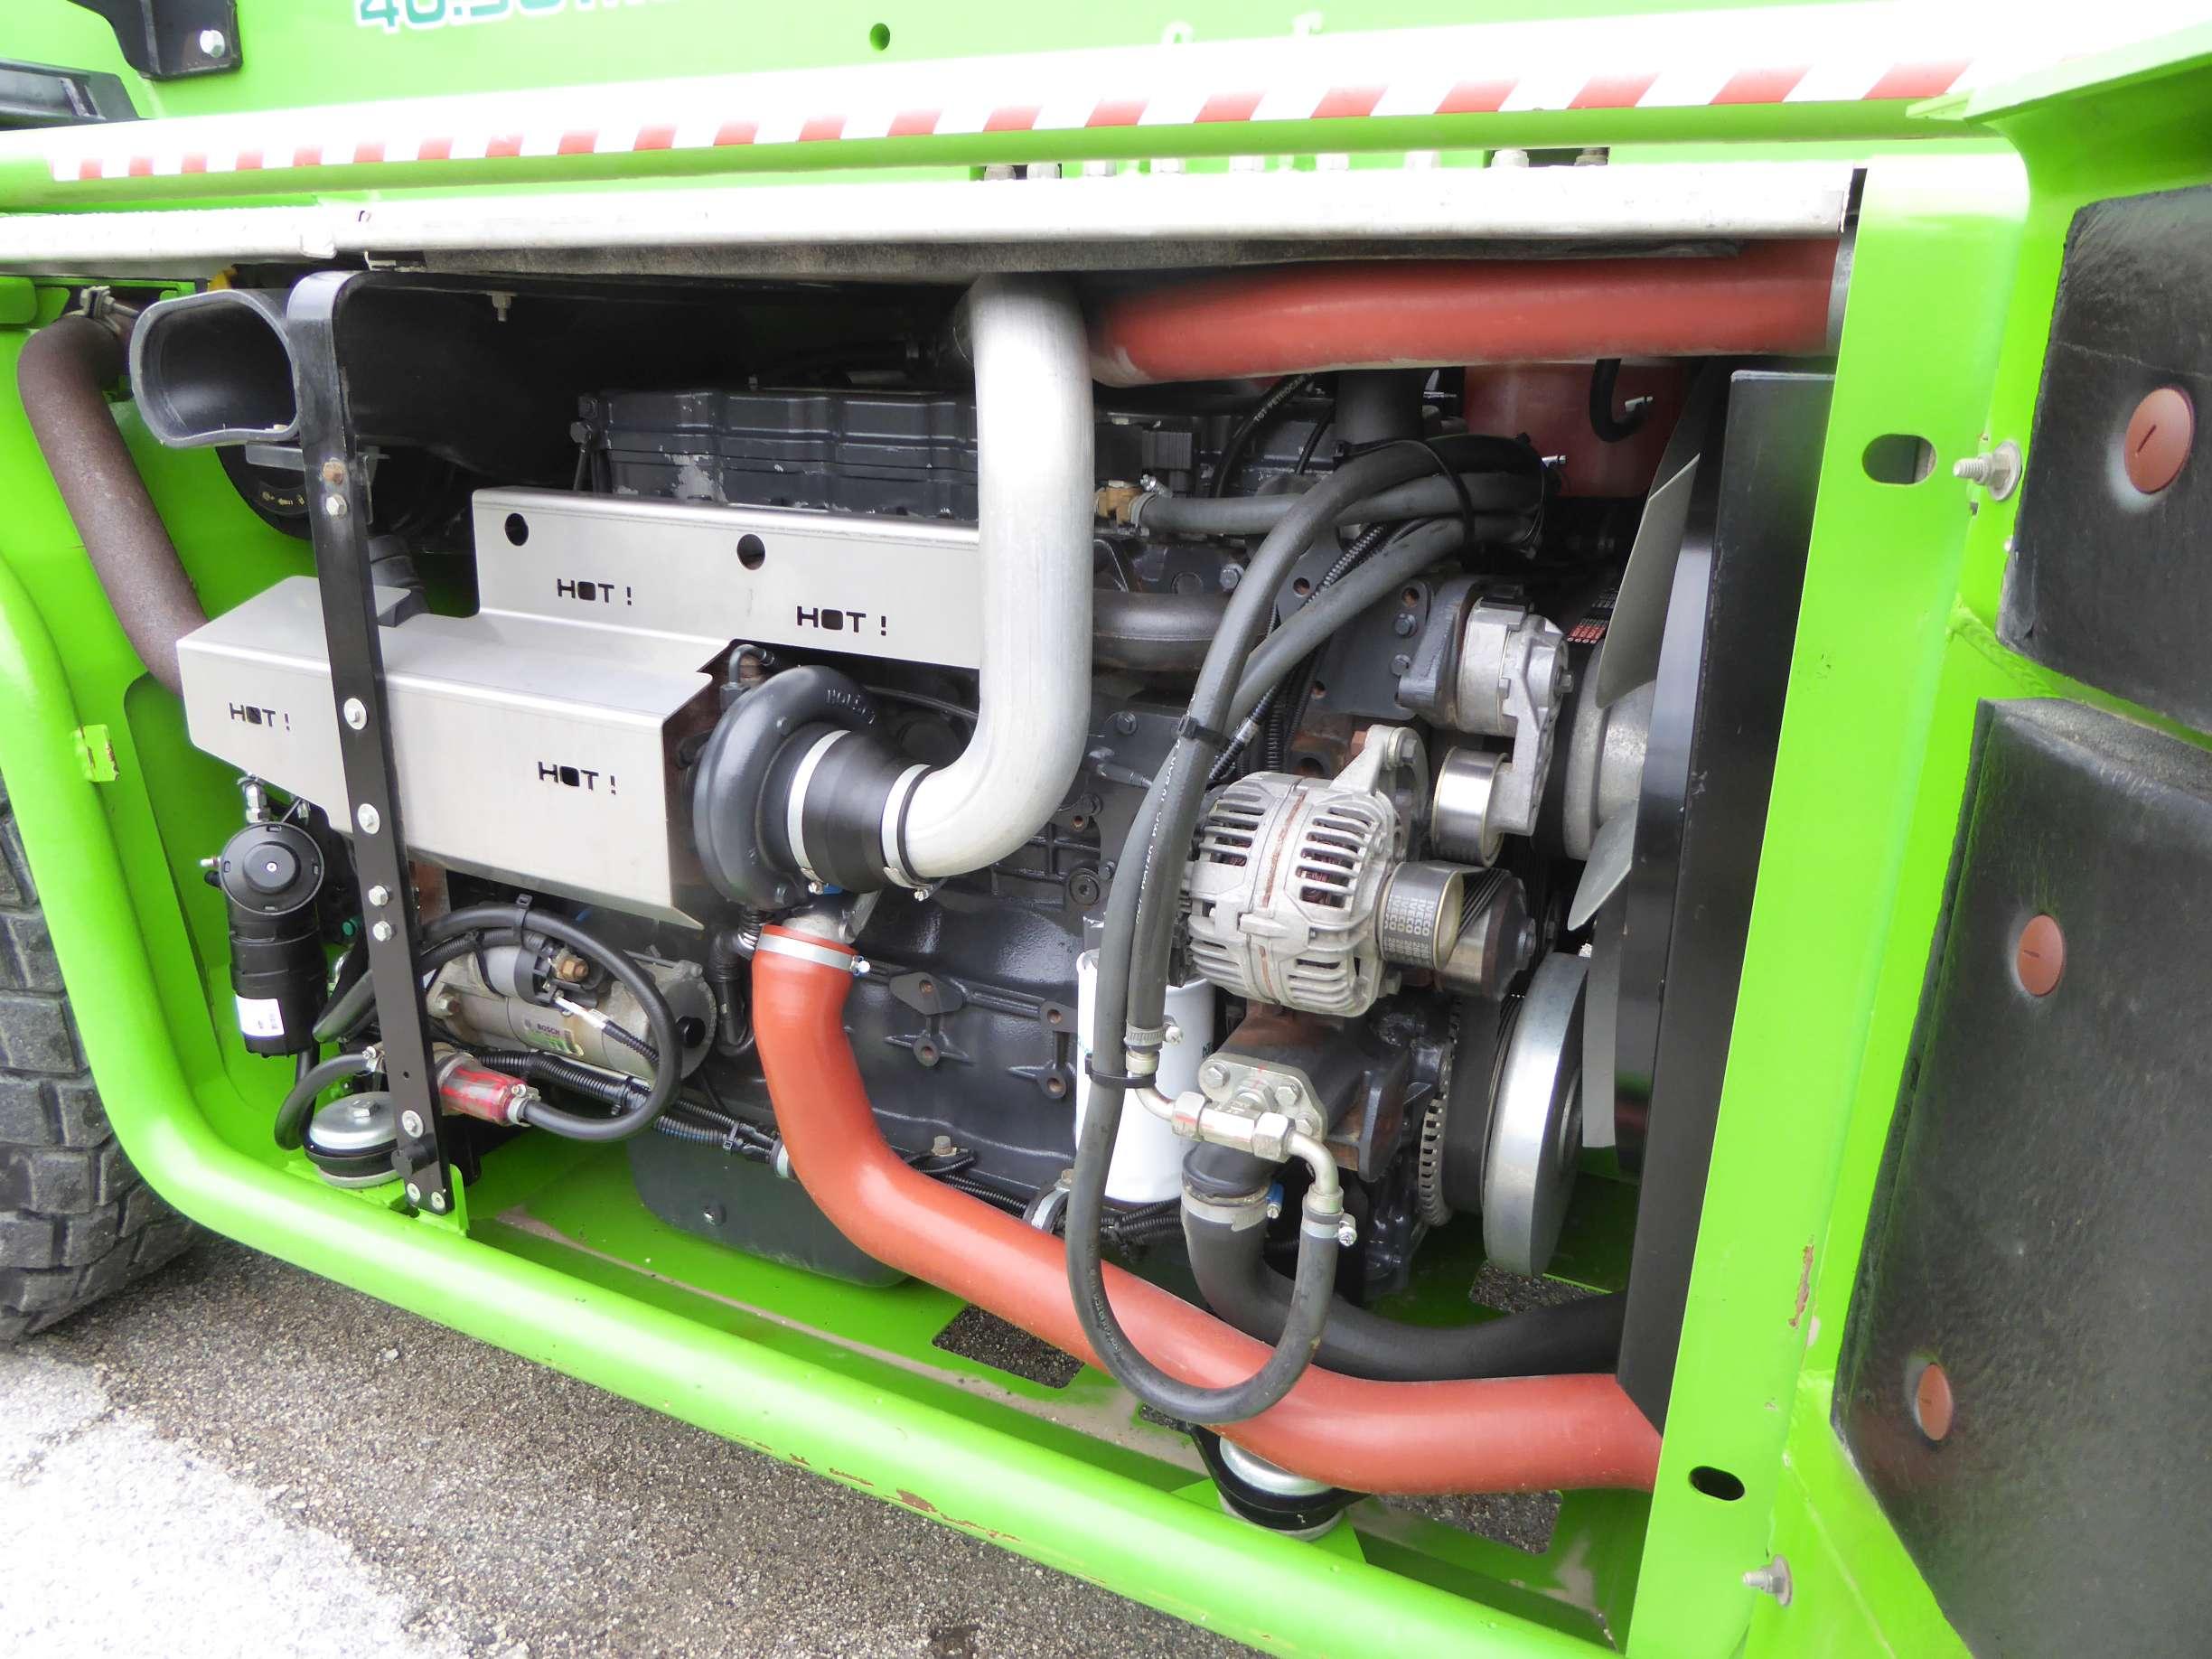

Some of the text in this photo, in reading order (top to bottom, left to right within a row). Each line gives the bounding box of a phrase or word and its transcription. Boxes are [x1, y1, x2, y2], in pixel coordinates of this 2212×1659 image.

[557, 578, 614, 604] HOT
[797, 605, 867, 633] HOT
[229, 702, 276, 727] HOT
[538, 761, 599, 791] HOT
[1405, 896, 1418, 933] IVECO
[1413, 898, 1427, 935] IVECO
